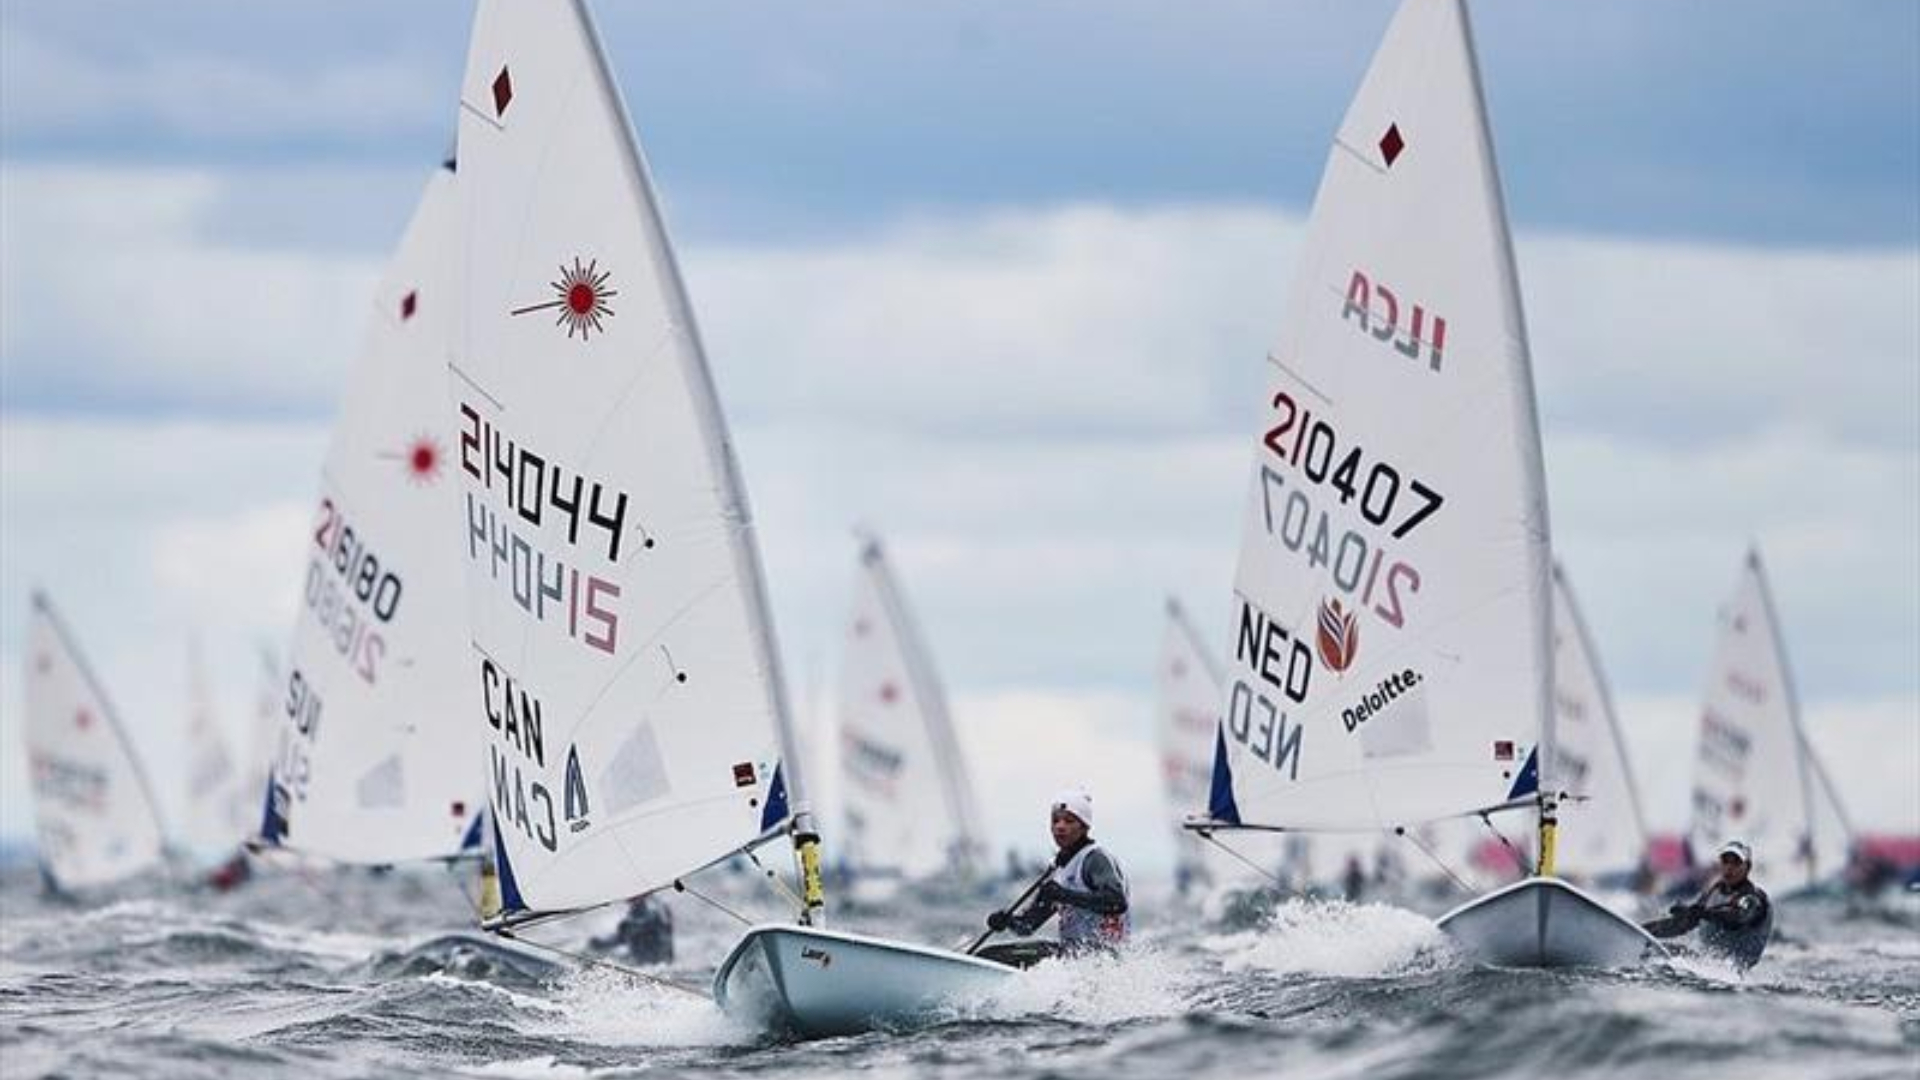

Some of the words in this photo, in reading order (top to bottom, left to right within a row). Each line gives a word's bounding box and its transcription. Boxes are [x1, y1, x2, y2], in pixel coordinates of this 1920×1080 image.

[460, 402, 628, 562] 214044
[1263, 391, 1444, 540] 210407
[314, 497, 402, 623] 216180
[1237, 602, 1312, 704] NED
[1341, 668, 1424, 733] Deloitte.
[482, 659, 545, 768] CAN
